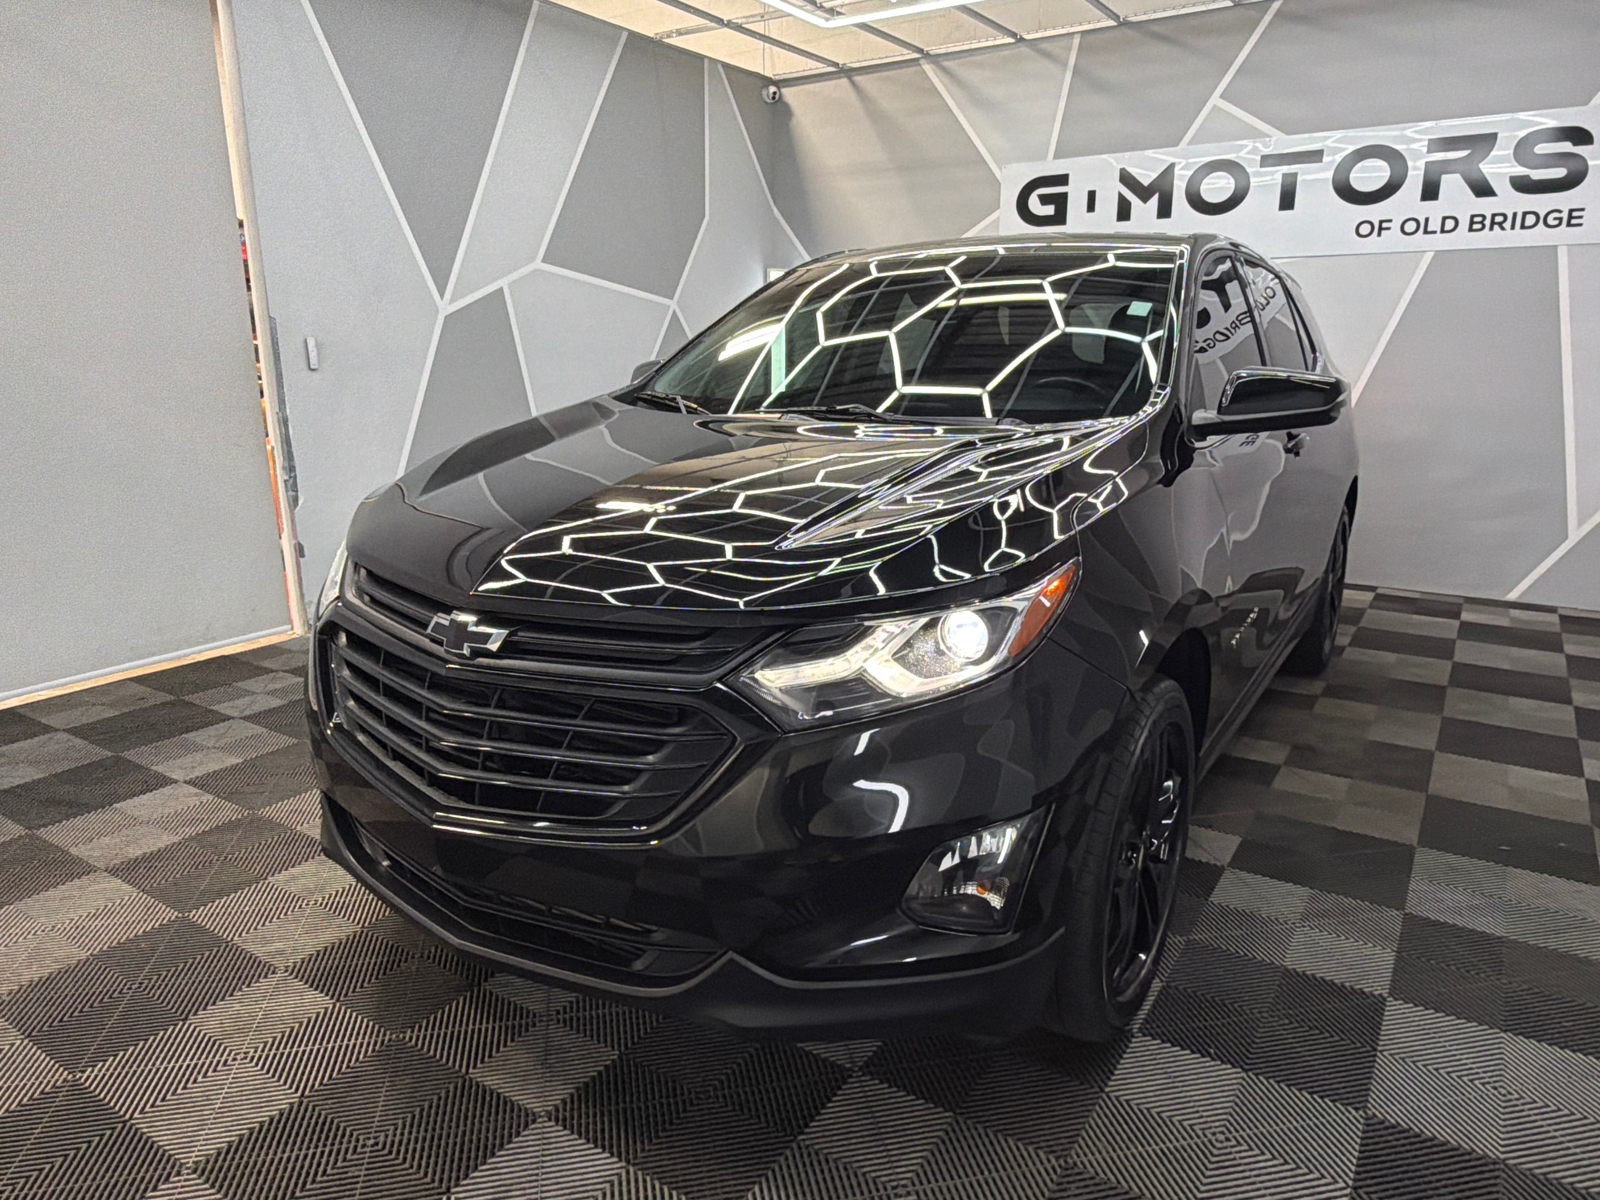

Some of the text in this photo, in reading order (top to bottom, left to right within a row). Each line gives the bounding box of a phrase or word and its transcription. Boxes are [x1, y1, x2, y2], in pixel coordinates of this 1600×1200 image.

[1355, 207, 1586, 238] OF OLD BRIDGE
